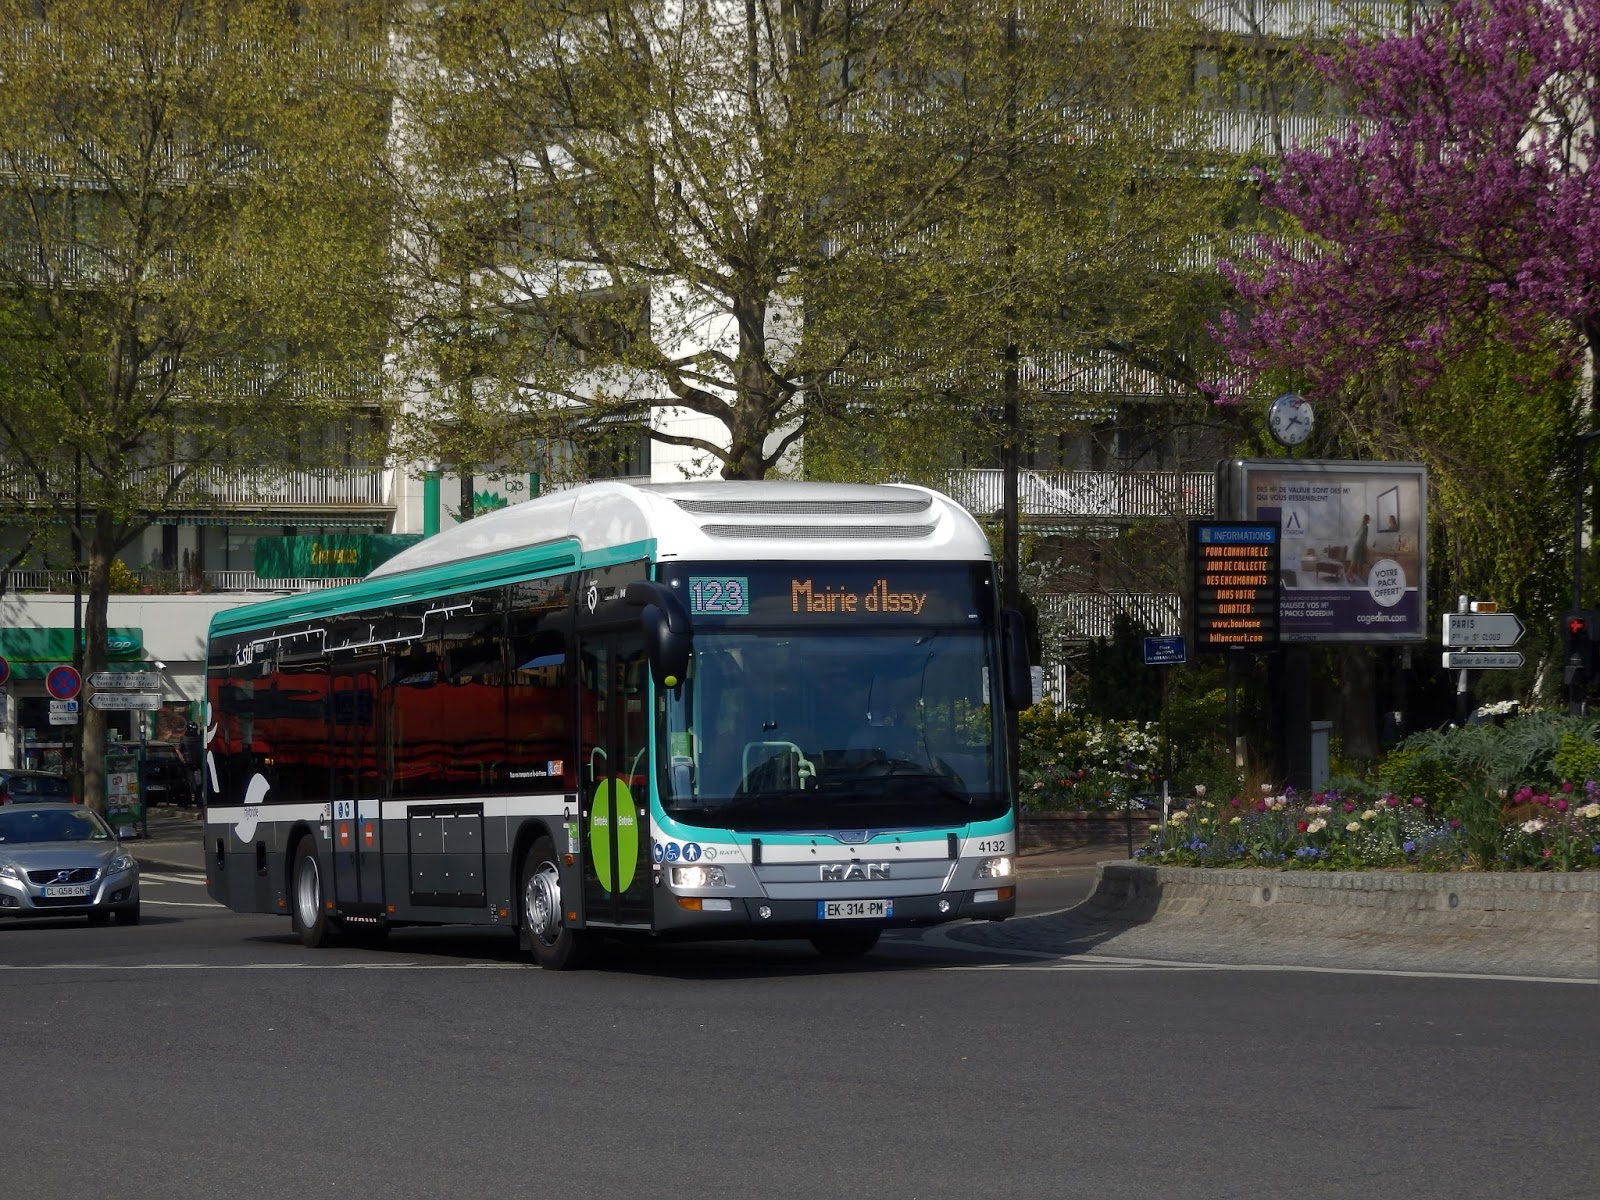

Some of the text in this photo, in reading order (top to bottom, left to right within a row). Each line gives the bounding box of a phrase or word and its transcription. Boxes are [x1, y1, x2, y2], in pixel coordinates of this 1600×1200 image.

[1276, 416, 1280, 425] 9
[1304, 417, 1310, 426] 3
[1290, 434, 1296, 442] 6
[505, 478, 524, 494] bp
[1214, 531, 1271, 540] INFORMATIONS
[1206, 547, 1268, 556] POUR CONNAITRE LE
[1207, 562, 1266, 571] JOUR DE COLLECTE
[1375, 569, 1398, 578] VOTRE
[1207, 576, 1267, 585] DES ENCOMBRANTS
[1378, 578, 1396, 587] PACK
[693, 580, 743, 612] 123
[792, 580, 926, 614] Mairie d'Issy
[1217, 590, 1256, 599] DANS VOTRE
[1357, 612, 1406, 624] cogedim.com
[1452, 620, 1475, 628] PARIS
[1210, 633, 1263, 642] billancourt.com
[594, 816, 607, 826] Entrée
[619, 815, 633, 825] Entrée
[979, 841, 1005, 852] 4132
[820, 864, 890, 880] MAN
